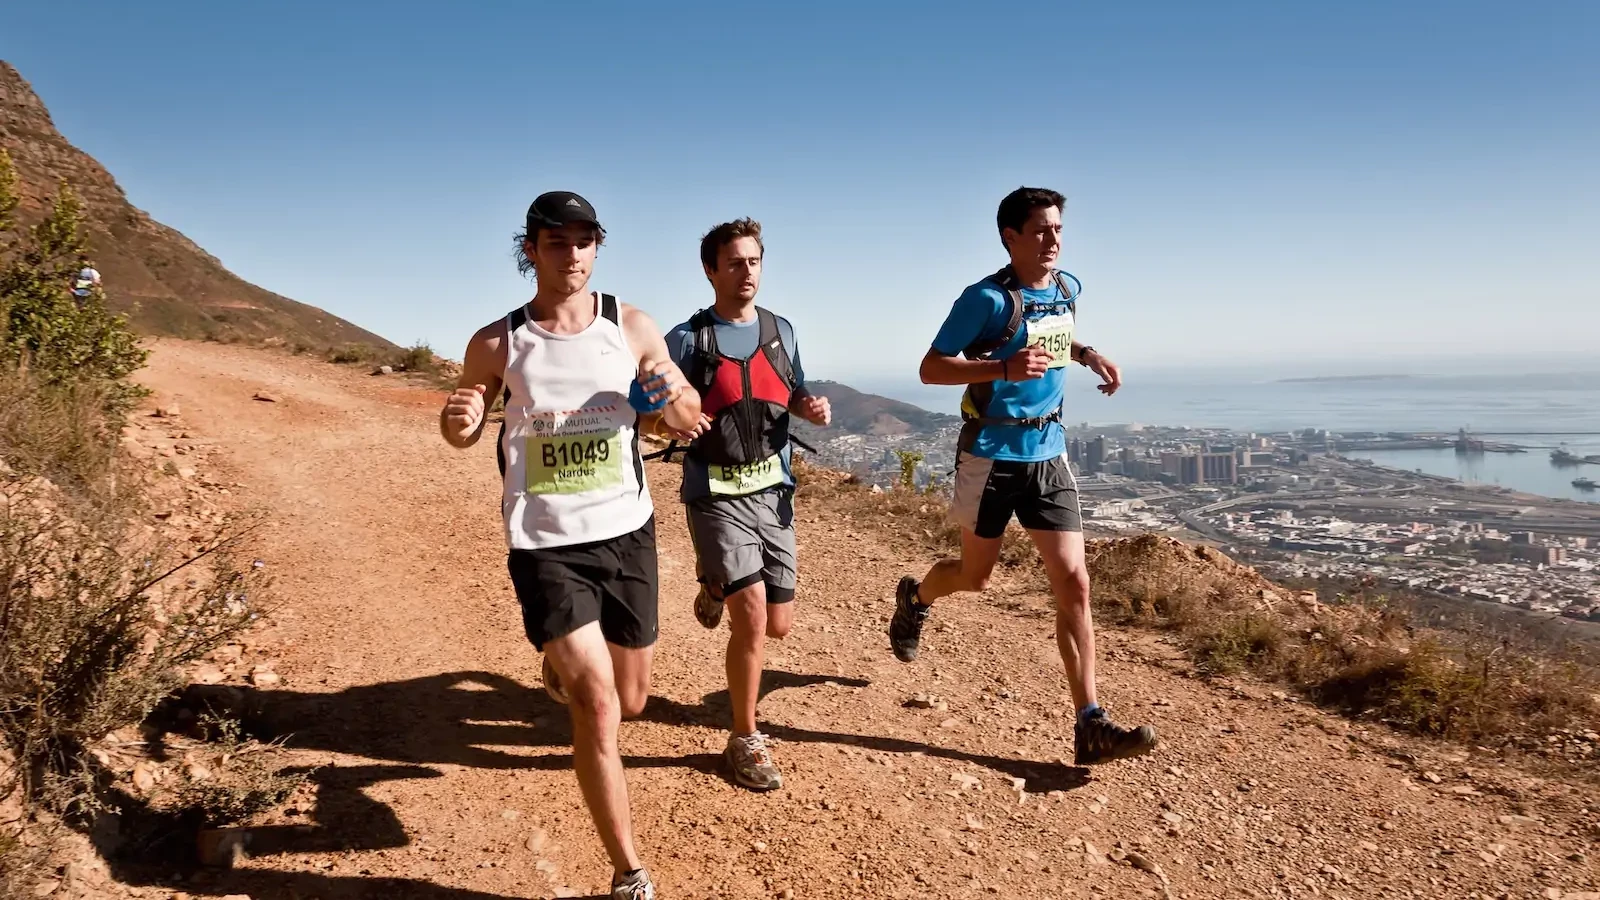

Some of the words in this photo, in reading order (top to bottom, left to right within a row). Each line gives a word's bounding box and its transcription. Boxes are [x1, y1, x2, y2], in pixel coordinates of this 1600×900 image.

[565, 417, 601, 427] MUTUAL
[542, 439, 610, 467] B1049
[558, 466, 596, 480] Nardus
